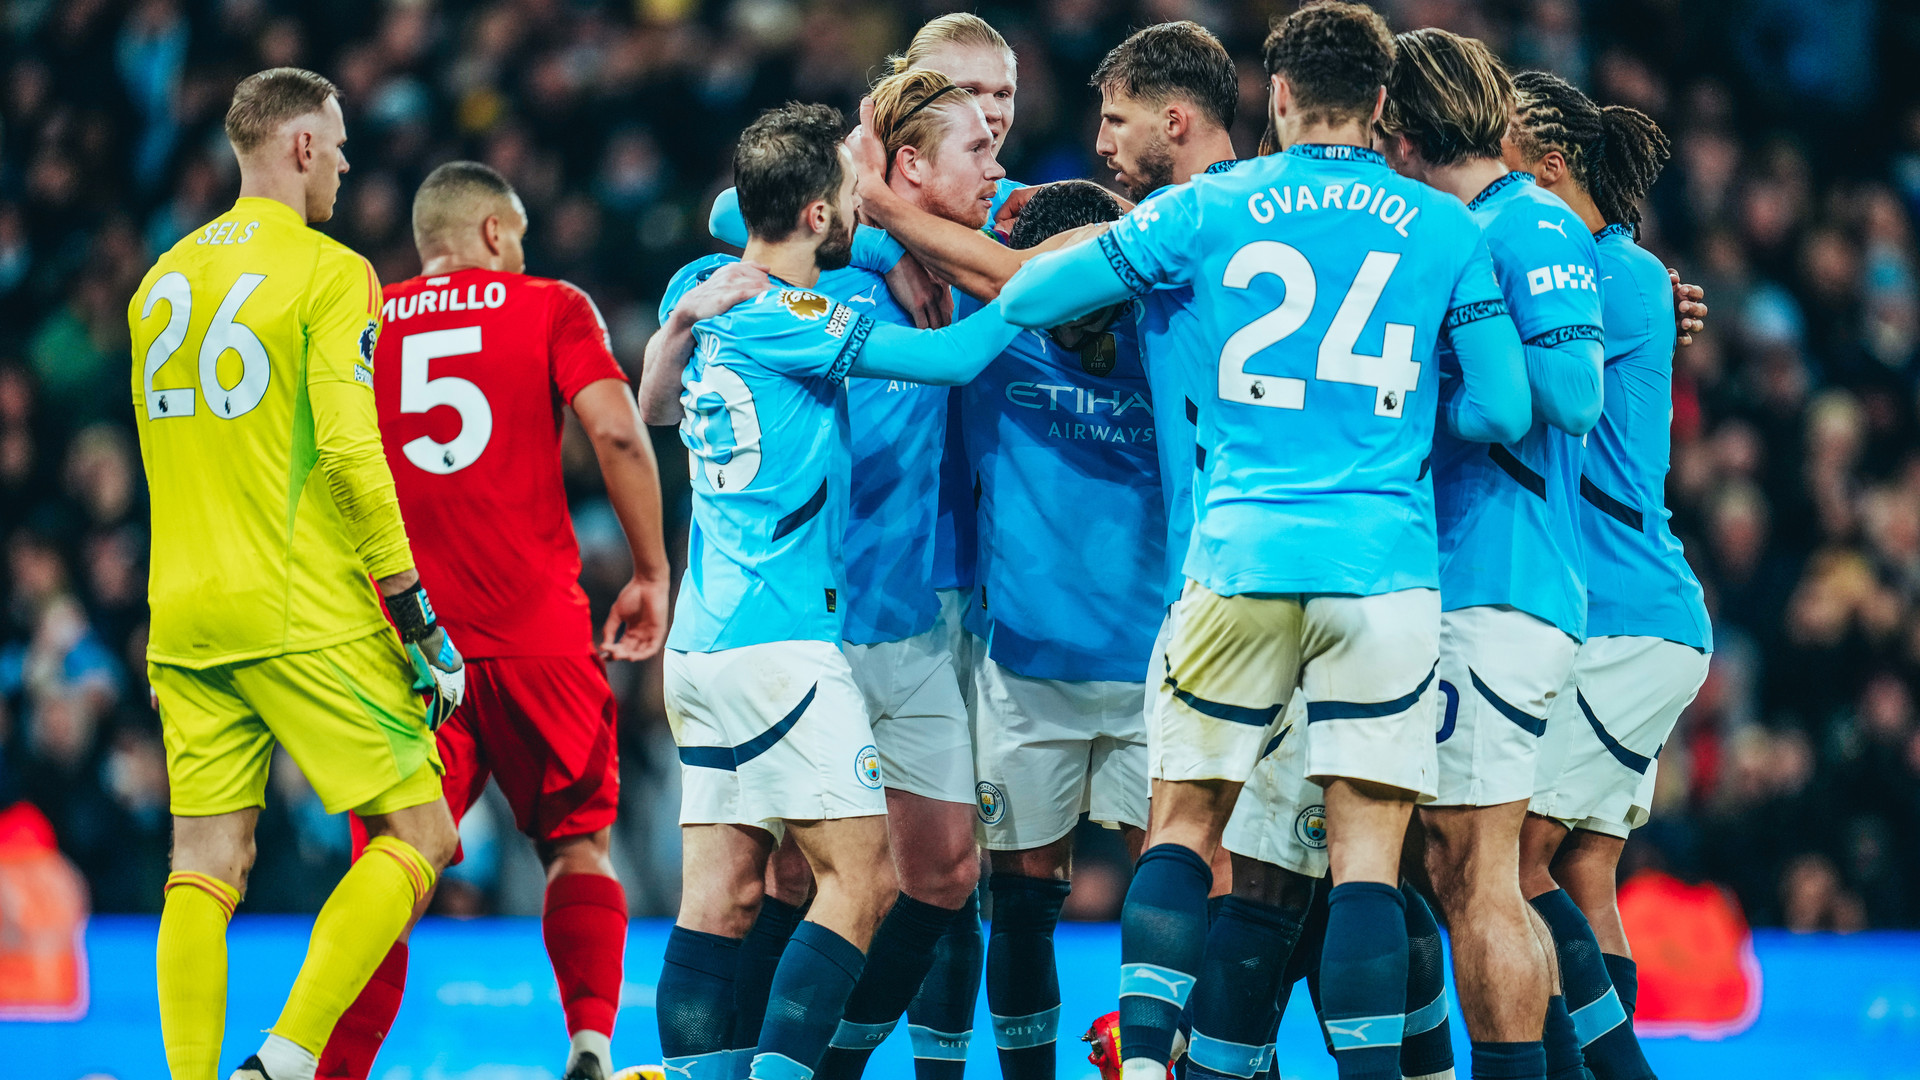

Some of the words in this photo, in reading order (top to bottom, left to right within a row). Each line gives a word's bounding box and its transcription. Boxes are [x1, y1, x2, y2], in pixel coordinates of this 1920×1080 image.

[1325, 146, 1351, 158] CITY
[1248, 182, 1422, 237] GVARDIOL
[197, 221, 260, 245] SELS
[1527, 264, 1597, 296] OKX
[1218, 240, 1421, 419] 24
[141, 271, 271, 421] 26
[1090, 361, 1106, 369] FIFA
[400, 326, 493, 475] 5
[1005, 381, 1154, 417] ETIHA
[1048, 422, 1154, 443] AIRWAYS
[1006, 1022, 1047, 1036] CITY
